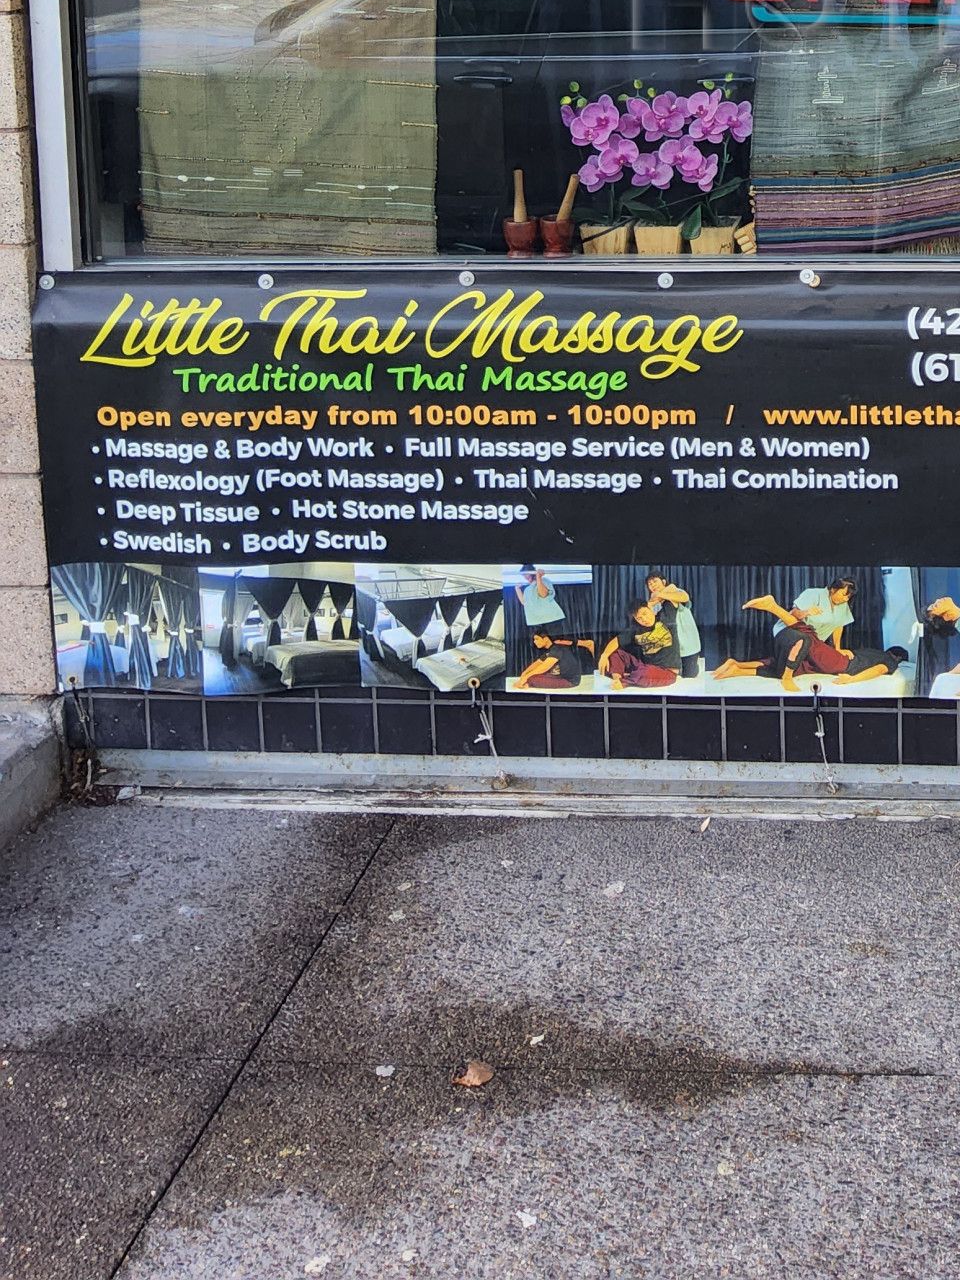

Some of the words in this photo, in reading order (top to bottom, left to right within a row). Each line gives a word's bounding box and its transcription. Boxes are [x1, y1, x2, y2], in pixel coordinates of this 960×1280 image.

[80, 293, 250, 367] Little
[259, 288, 418, 361] Thai
[425, 288, 744, 380] Massage
[173, 363, 373, 394] Traditional
[388, 363, 466, 392] Thai
[481, 366, 628, 400] Massage
[96, 406, 171, 431] Open
[181, 406, 319, 431] everyday
[327, 405, 398, 427] from
[408, 405, 537, 426] 10:00am
[567, 405, 696, 430] 10:00pm
[725, 403, 734, 426] /
[105, 439, 208, 463] Massage
[214, 440, 230, 460] &
[236, 438, 302, 463] Body
[307, 437, 374, 459] Work
[405, 437, 452, 458] Full
[457, 437, 566, 462] Massage
[571, 437, 664, 459] Service
[670, 437, 735, 461] (Men
[740, 437, 756, 459] &
[761, 437, 870, 460] Women)
[108, 469, 250, 494] Reflexology
[255, 468, 322, 493] (Foot
[327, 468, 444, 494] Massage)
[473, 469, 528, 490] Thai
[532, 469, 642, 494] Massage
[671, 468, 726, 490] Thai
[731, 468, 899, 490] Combination
[115, 500, 176, 526] Deep
[180, 502, 260, 523] Tissue
[291, 499, 339, 520] Hot
[342, 499, 415, 521] Stone
[420, 500, 529, 525] Massage
[113, 530, 212, 555] Swedish
[242, 530, 310, 556] Body
[315, 529, 387, 552] Scrub
